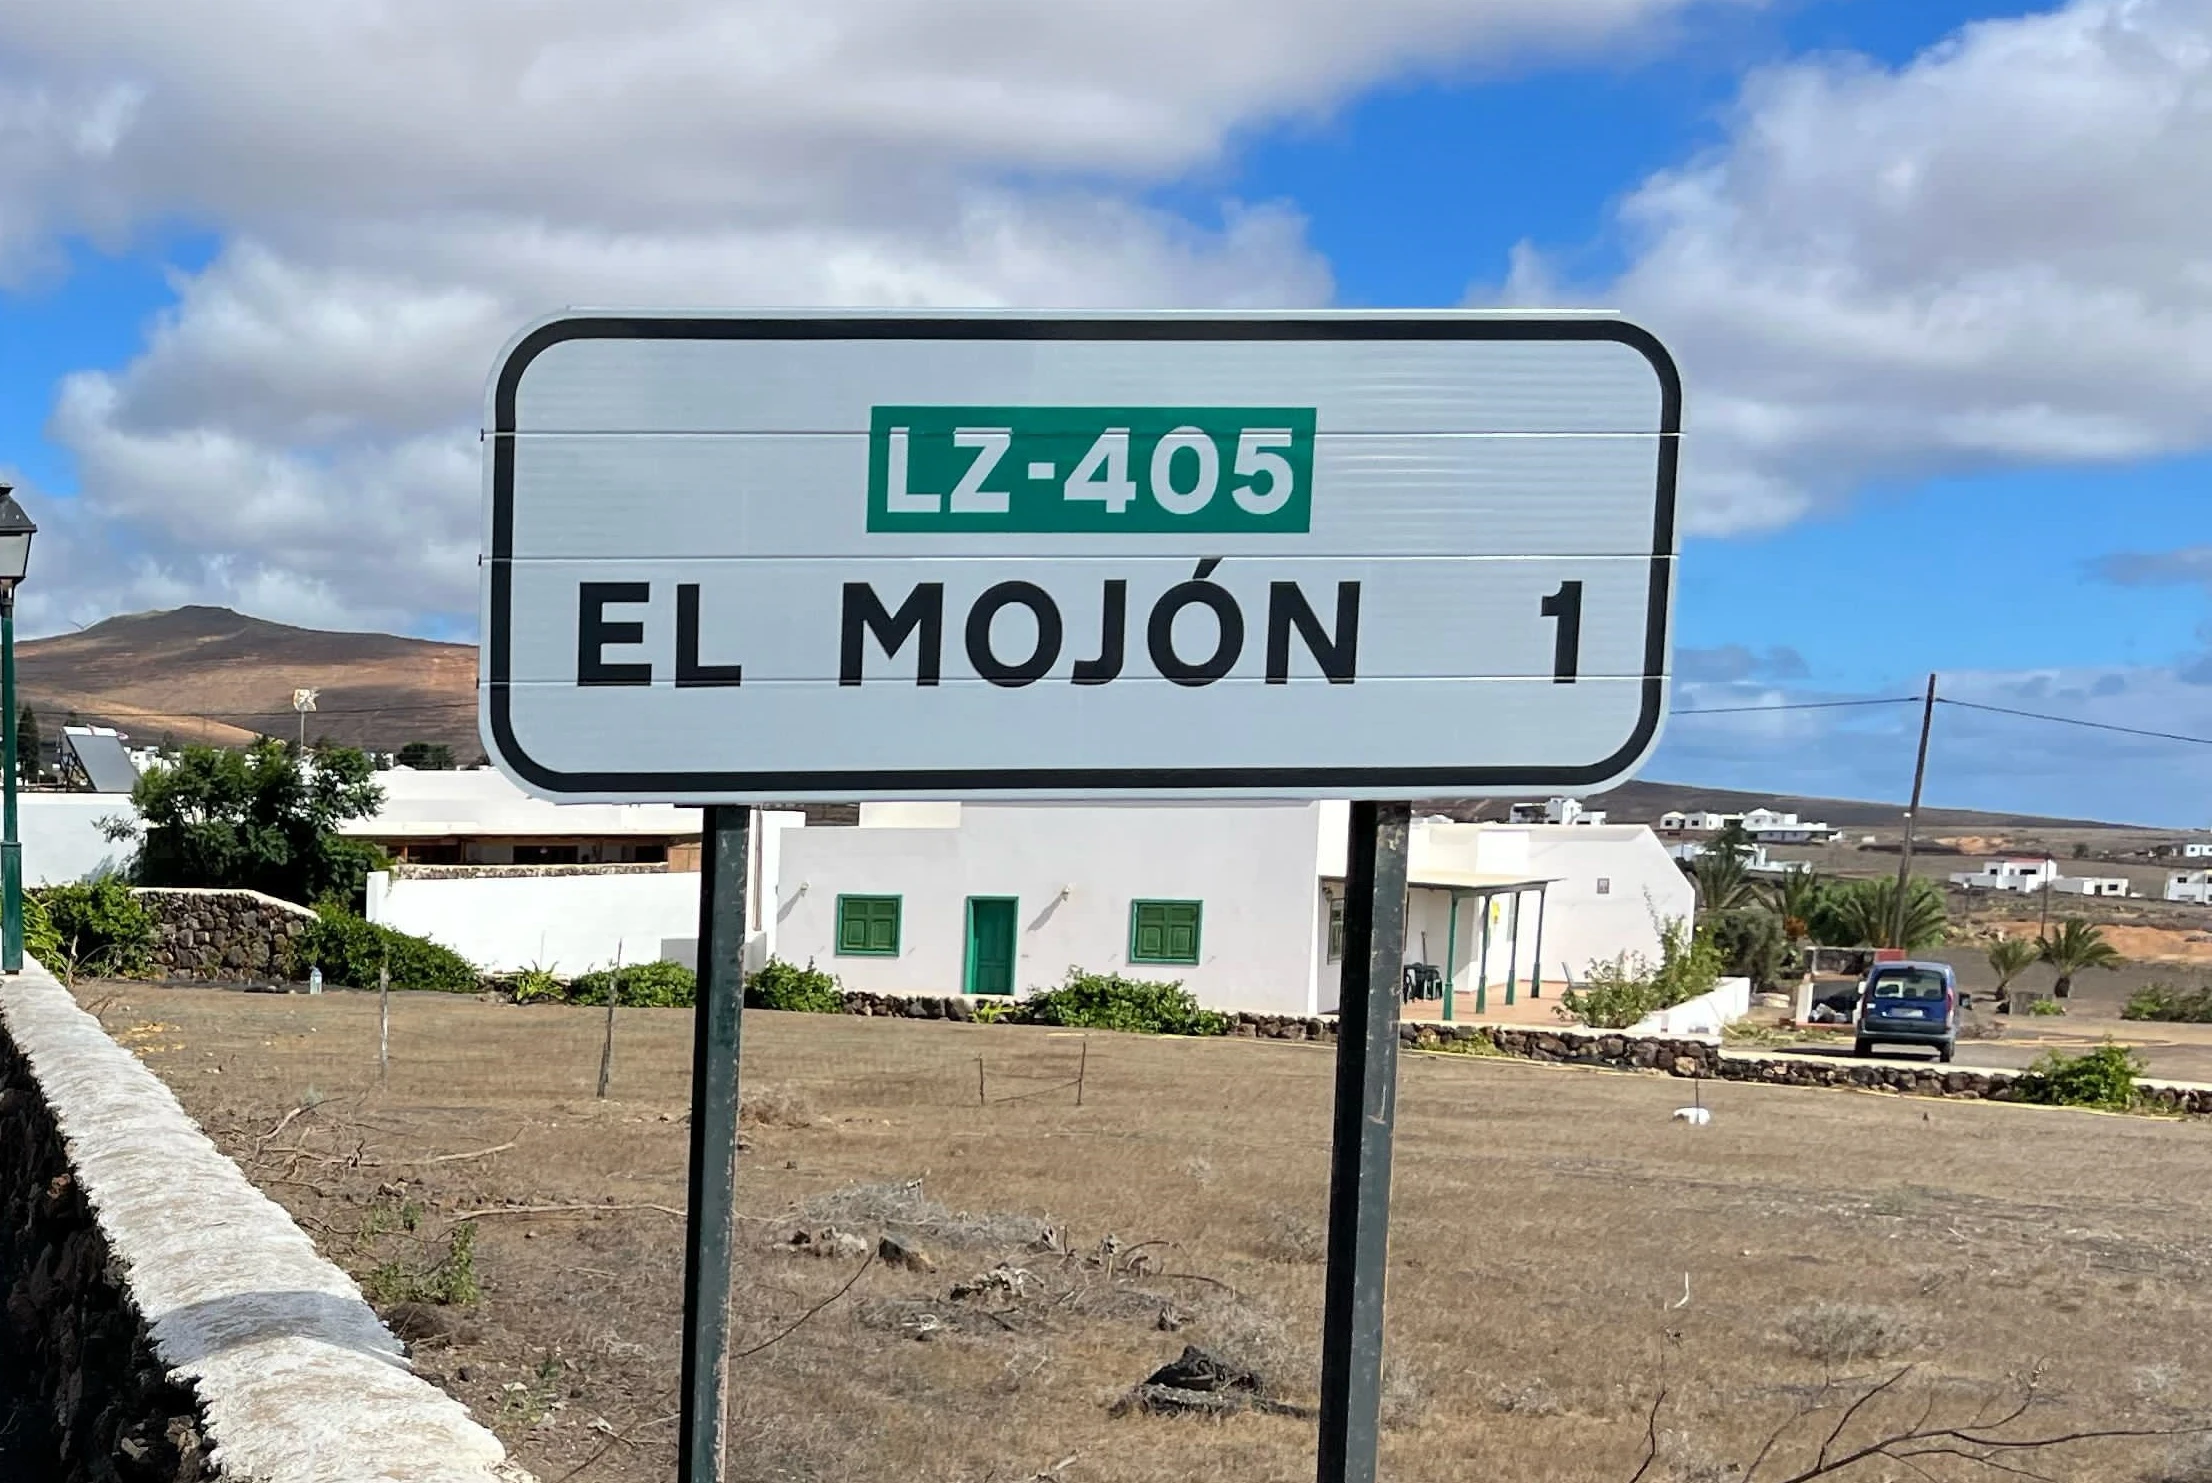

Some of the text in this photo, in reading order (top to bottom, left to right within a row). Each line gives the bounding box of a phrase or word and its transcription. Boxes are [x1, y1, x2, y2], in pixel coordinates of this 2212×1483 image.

[887, 426, 1294, 515] LZ-405
[577, 557, 1583, 688] EL MOJÓN 1
